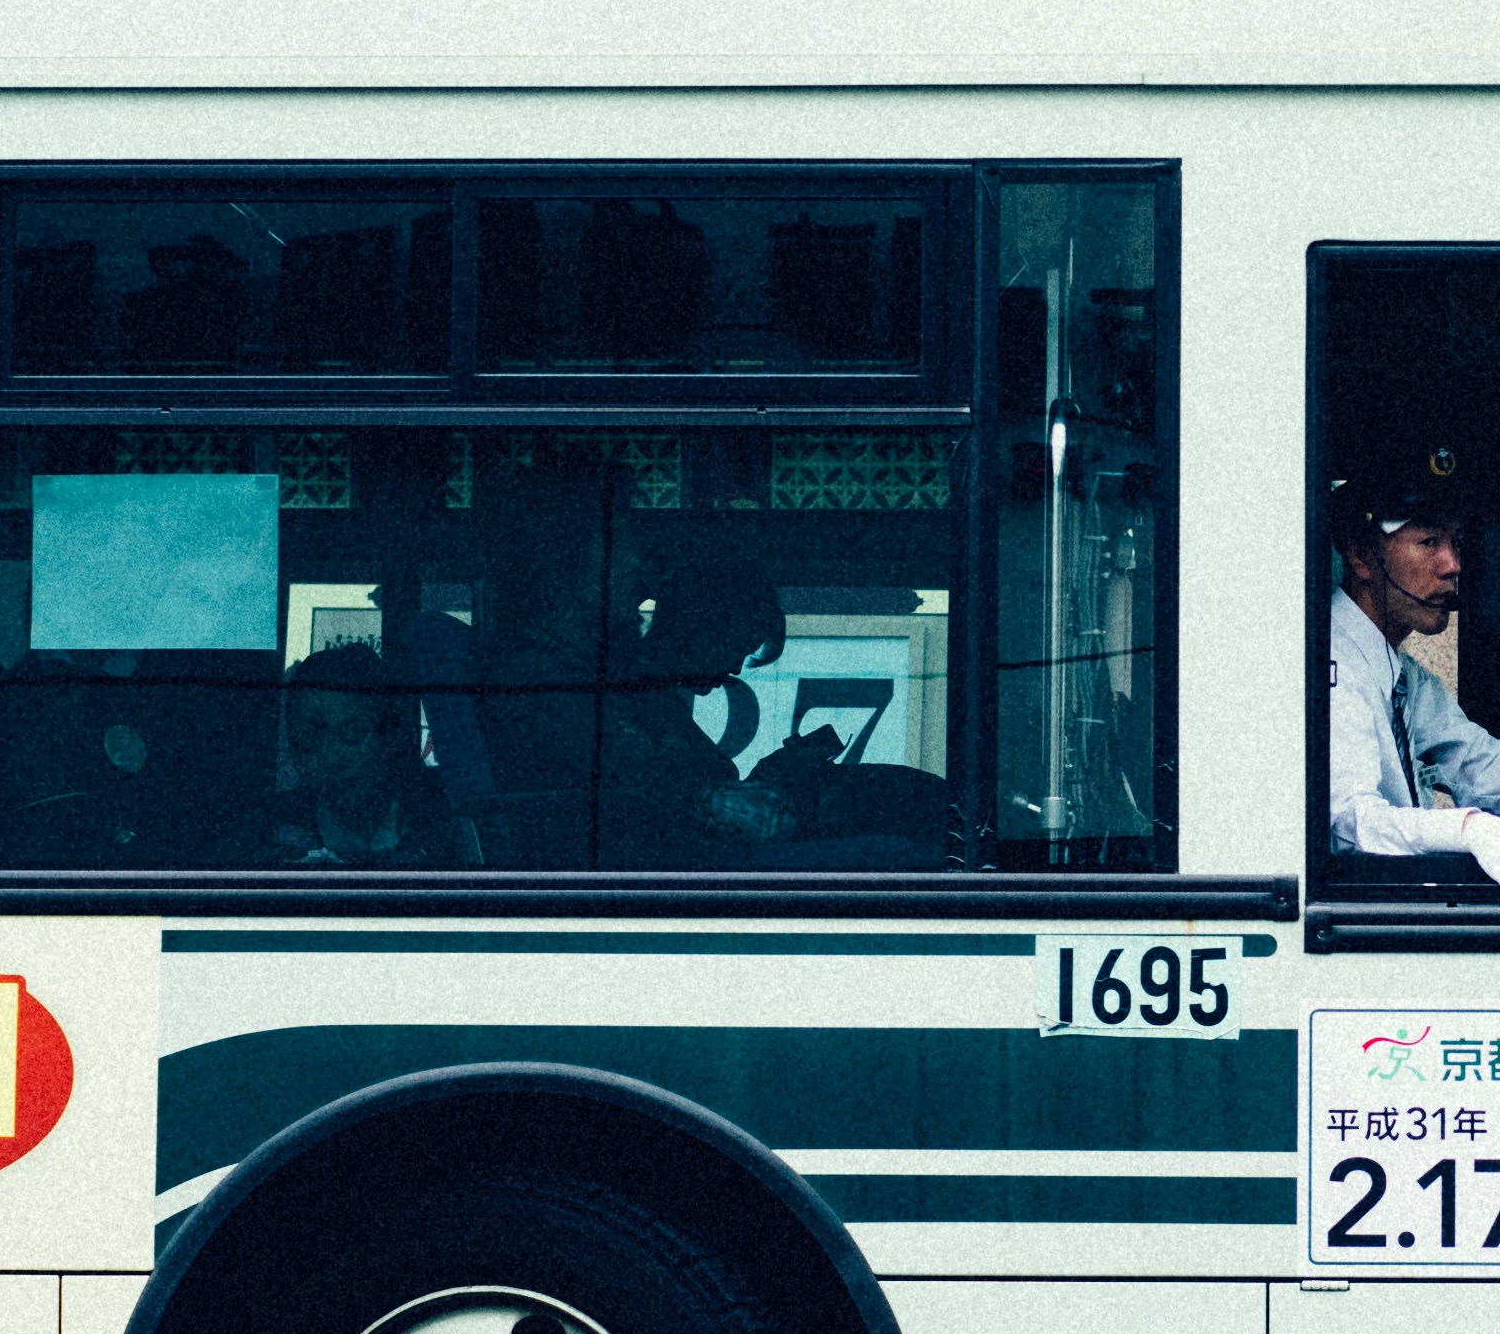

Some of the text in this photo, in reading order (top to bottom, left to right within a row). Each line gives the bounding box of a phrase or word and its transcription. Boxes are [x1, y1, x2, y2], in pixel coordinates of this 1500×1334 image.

[1059, 946, 1229, 1027] 1695
[1326, 1106, 1488, 1142] 平成31年
